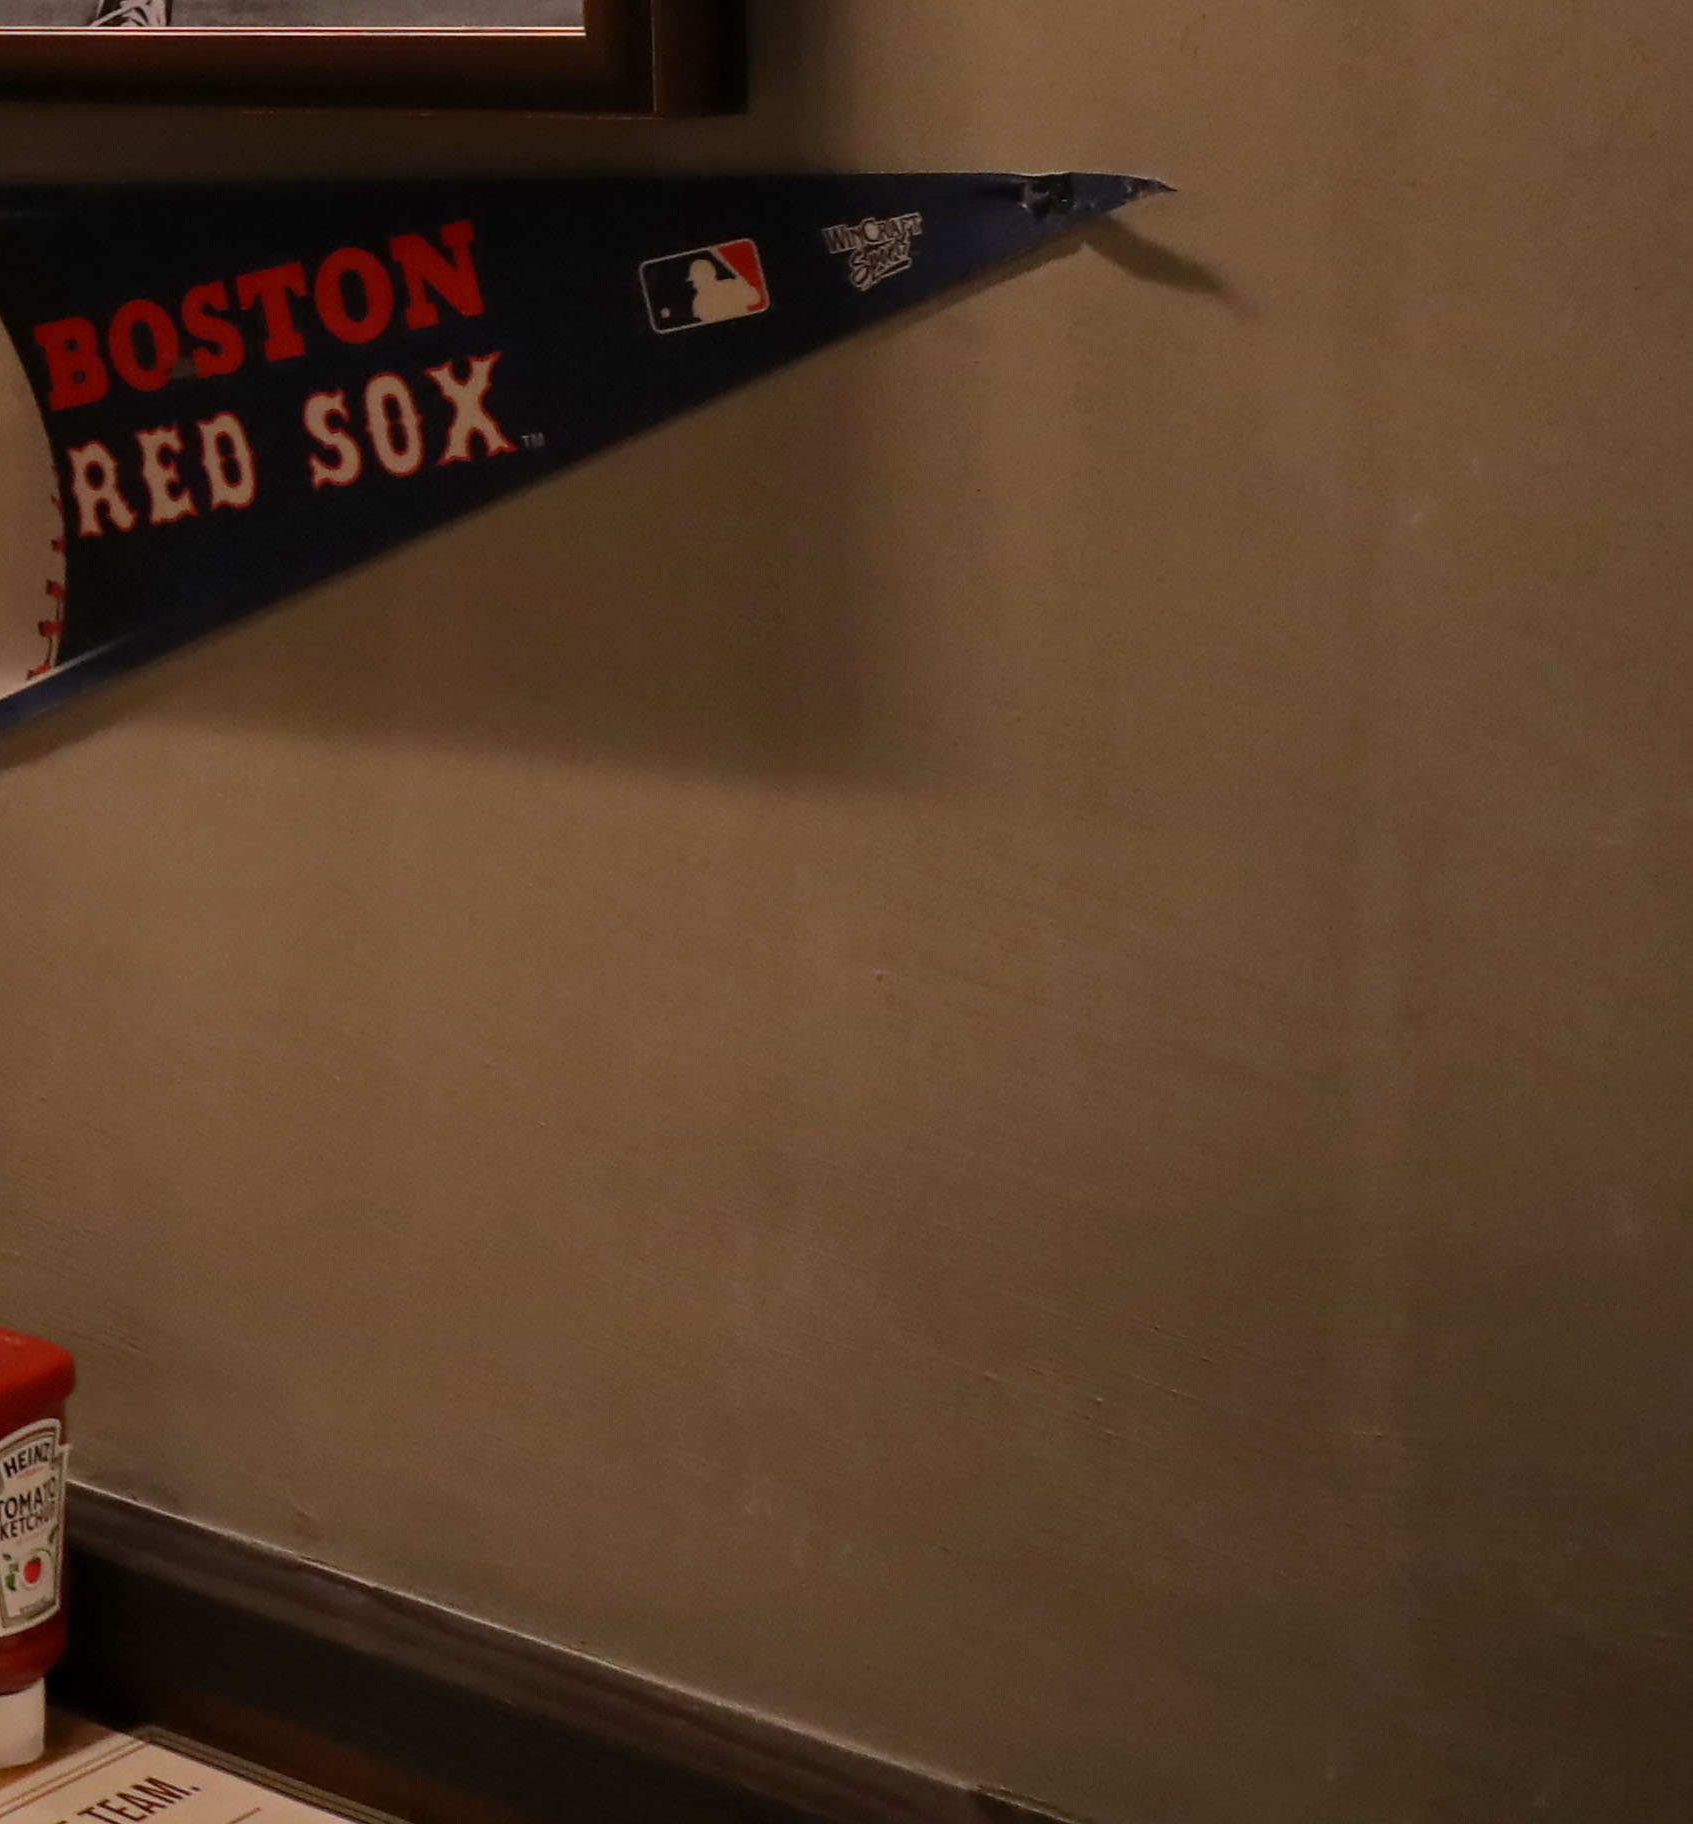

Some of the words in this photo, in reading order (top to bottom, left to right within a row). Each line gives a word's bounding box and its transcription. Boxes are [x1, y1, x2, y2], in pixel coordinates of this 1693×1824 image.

[33, 218, 485, 412] BOSTON
[66, 411, 258, 537] RED
[303, 351, 517, 491] SOX
[3, 1442, 50, 1478] HEINZ
[0, 1502, 56, 1542] KETCH
[76, 1776, 201, 1824] TEAM.
